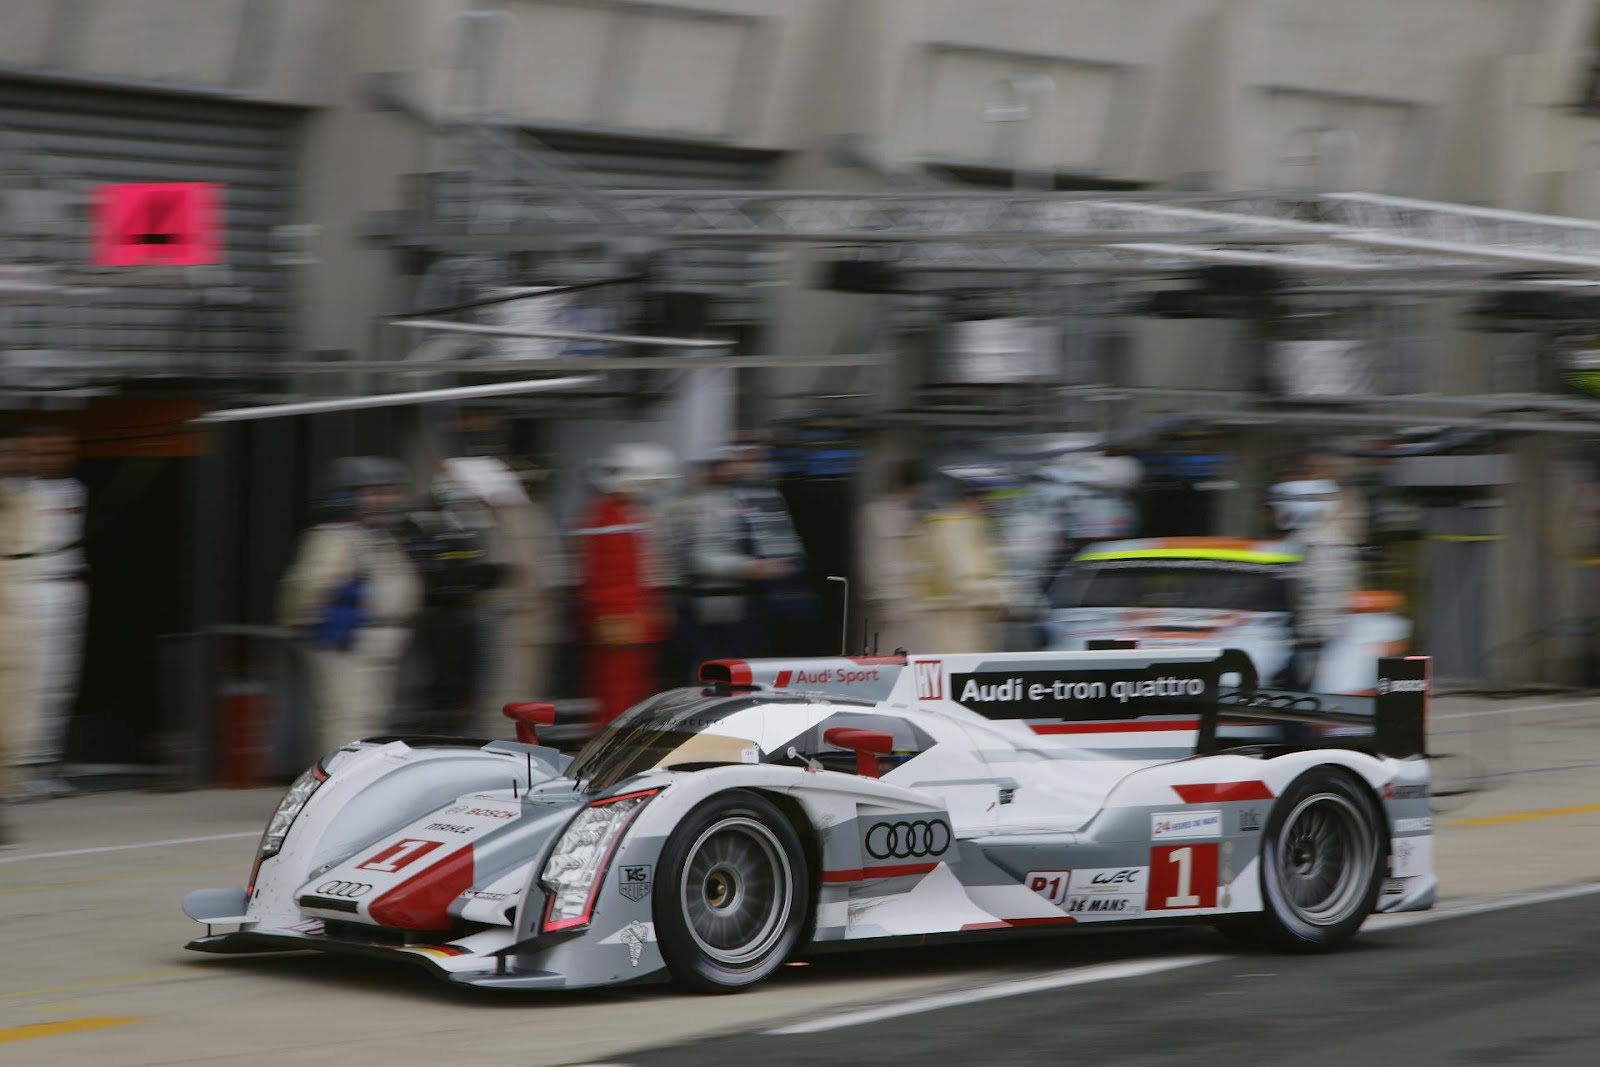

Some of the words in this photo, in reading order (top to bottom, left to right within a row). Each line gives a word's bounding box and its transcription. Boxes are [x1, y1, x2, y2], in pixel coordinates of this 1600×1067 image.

[796, 670, 832, 684] Audi
[836, 668, 880, 686] Sport
[960, 678, 1023, 702] Audi
[1027, 679, 1107, 701] e-tron
[1110, 676, 1206, 703] quattro
[465, 807, 519, 819] BOSCH
[424, 822, 475, 834] MAHLE
[362, 839, 430, 870] 1
[625, 867, 647, 882] TAG
[1091, 869, 1140, 884] WEC
[1165, 846, 1200, 908] 1
[1031, 876, 1061, 900] P1
[1088, 899, 1130, 912] MANS
